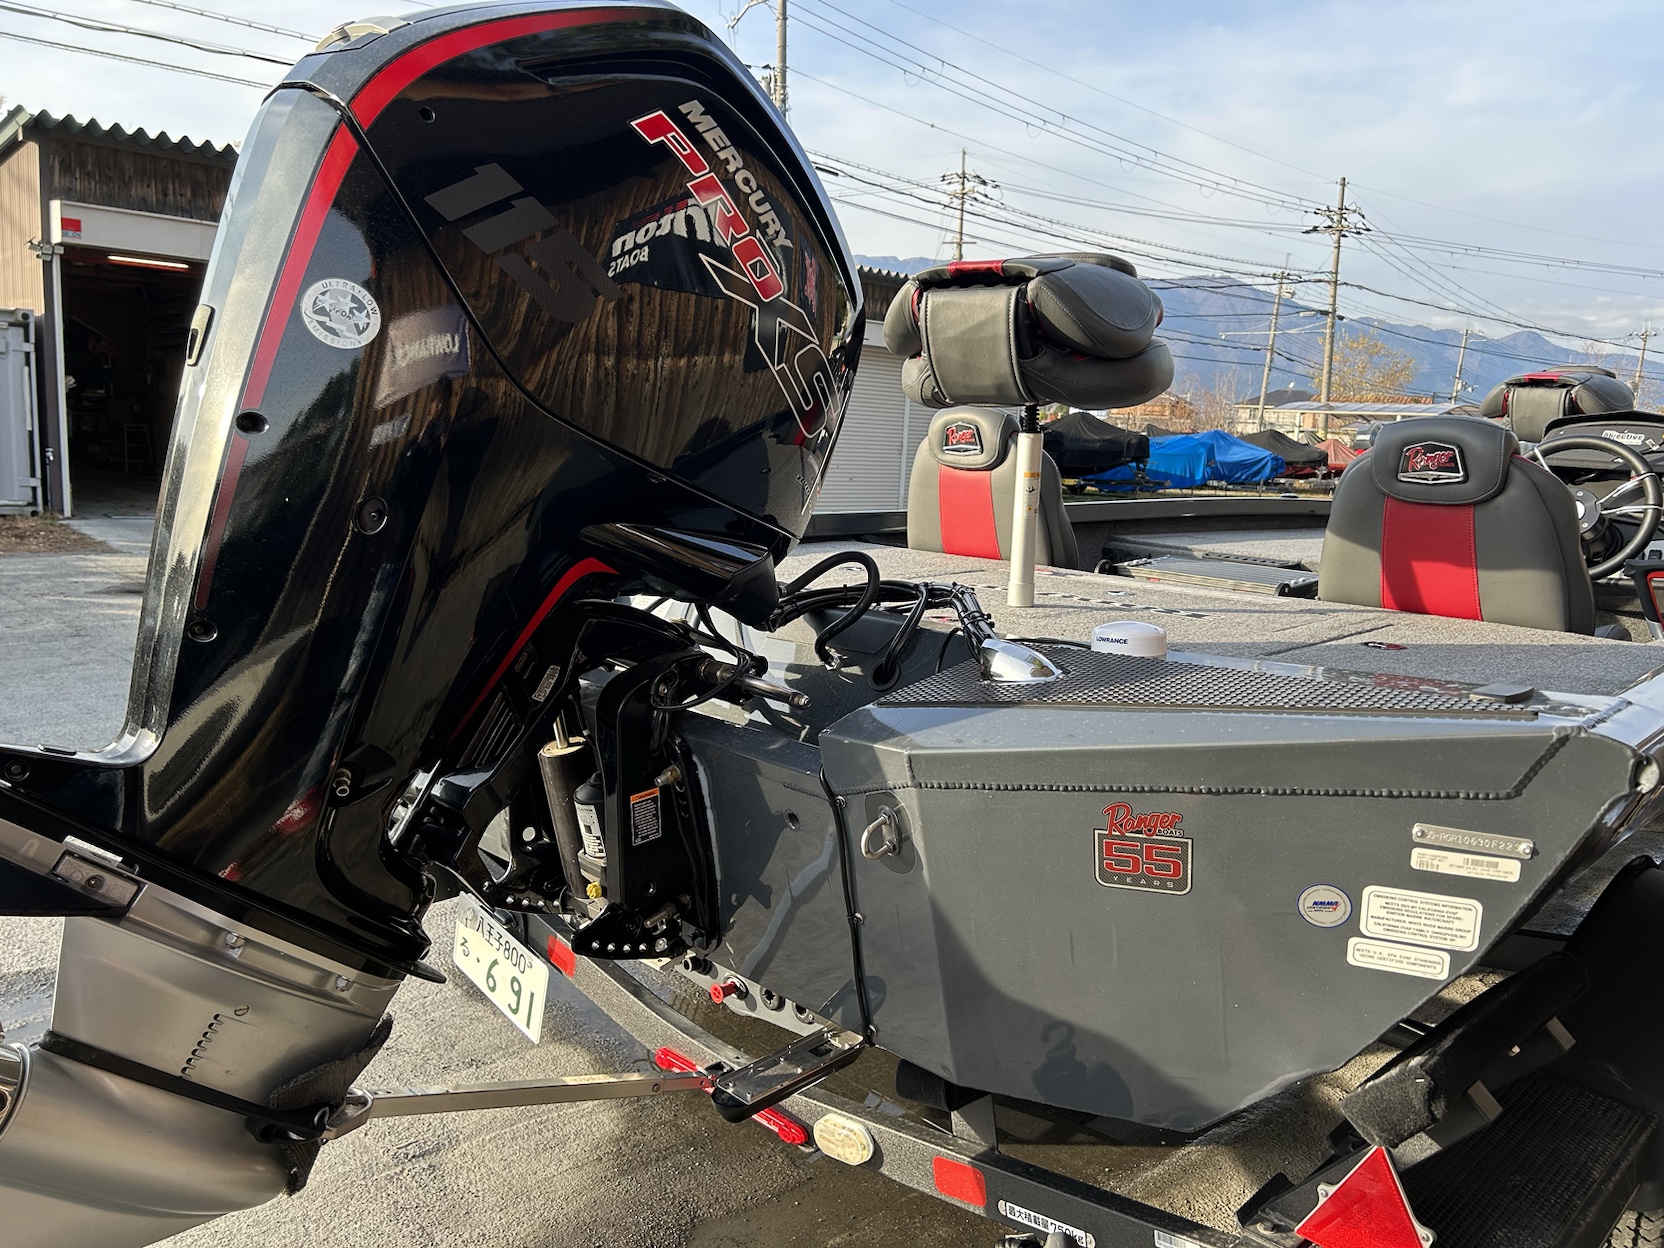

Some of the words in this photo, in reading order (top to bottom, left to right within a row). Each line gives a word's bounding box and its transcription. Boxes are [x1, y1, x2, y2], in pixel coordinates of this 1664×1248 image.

[677, 99, 794, 248] MERCURY
[628, 109, 784, 303] PRO
[424, 162, 626, 324] 115
[307, 319, 357, 347] EMISSION
[1405, 446, 1455, 473] Ranger
[1095, 635, 1129, 645] LOWRANCE
[1101, 801, 1184, 838] Ranger
[1157, 828, 1185, 837] BOATS
[1103, 839, 1183, 880] 55
[1113, 875, 1174, 888] YEARS
